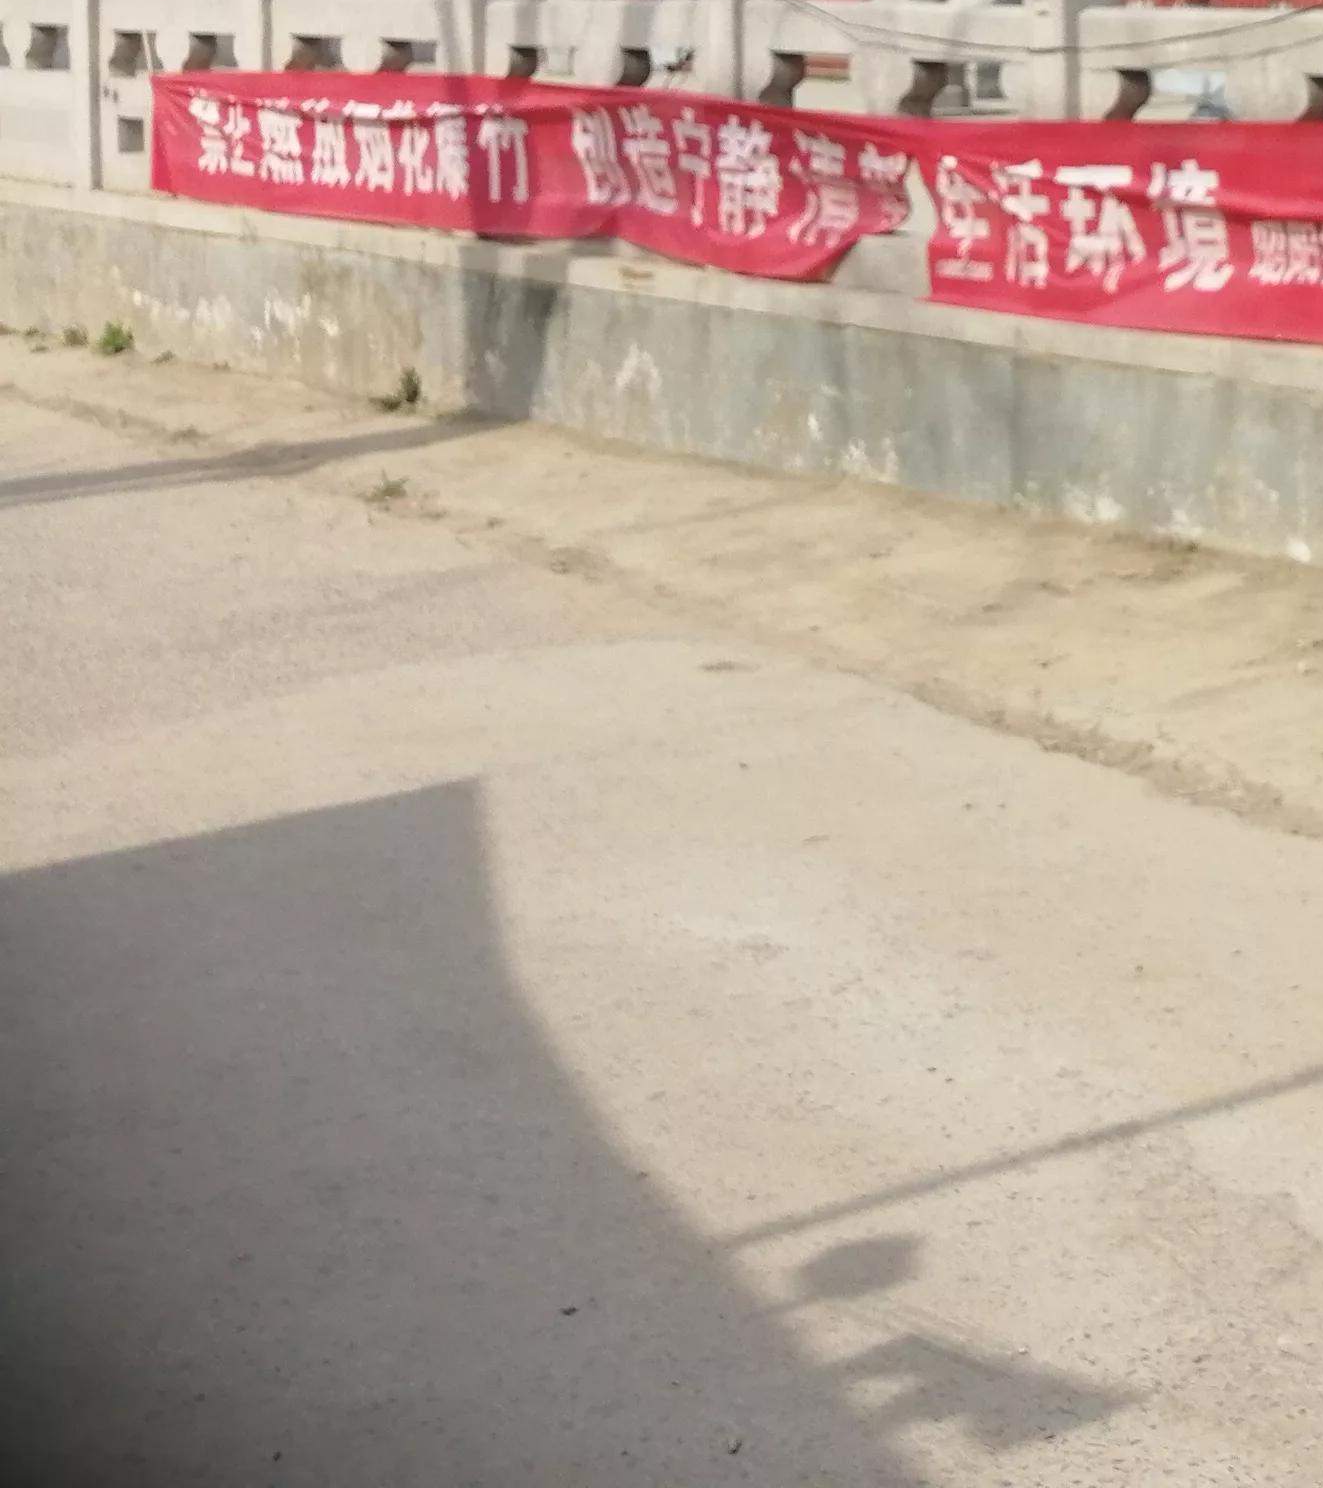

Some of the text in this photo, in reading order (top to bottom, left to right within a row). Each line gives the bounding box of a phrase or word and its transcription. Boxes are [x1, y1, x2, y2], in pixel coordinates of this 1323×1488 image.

[188, 88, 530, 203] 禁止燃放烟花爆竹
